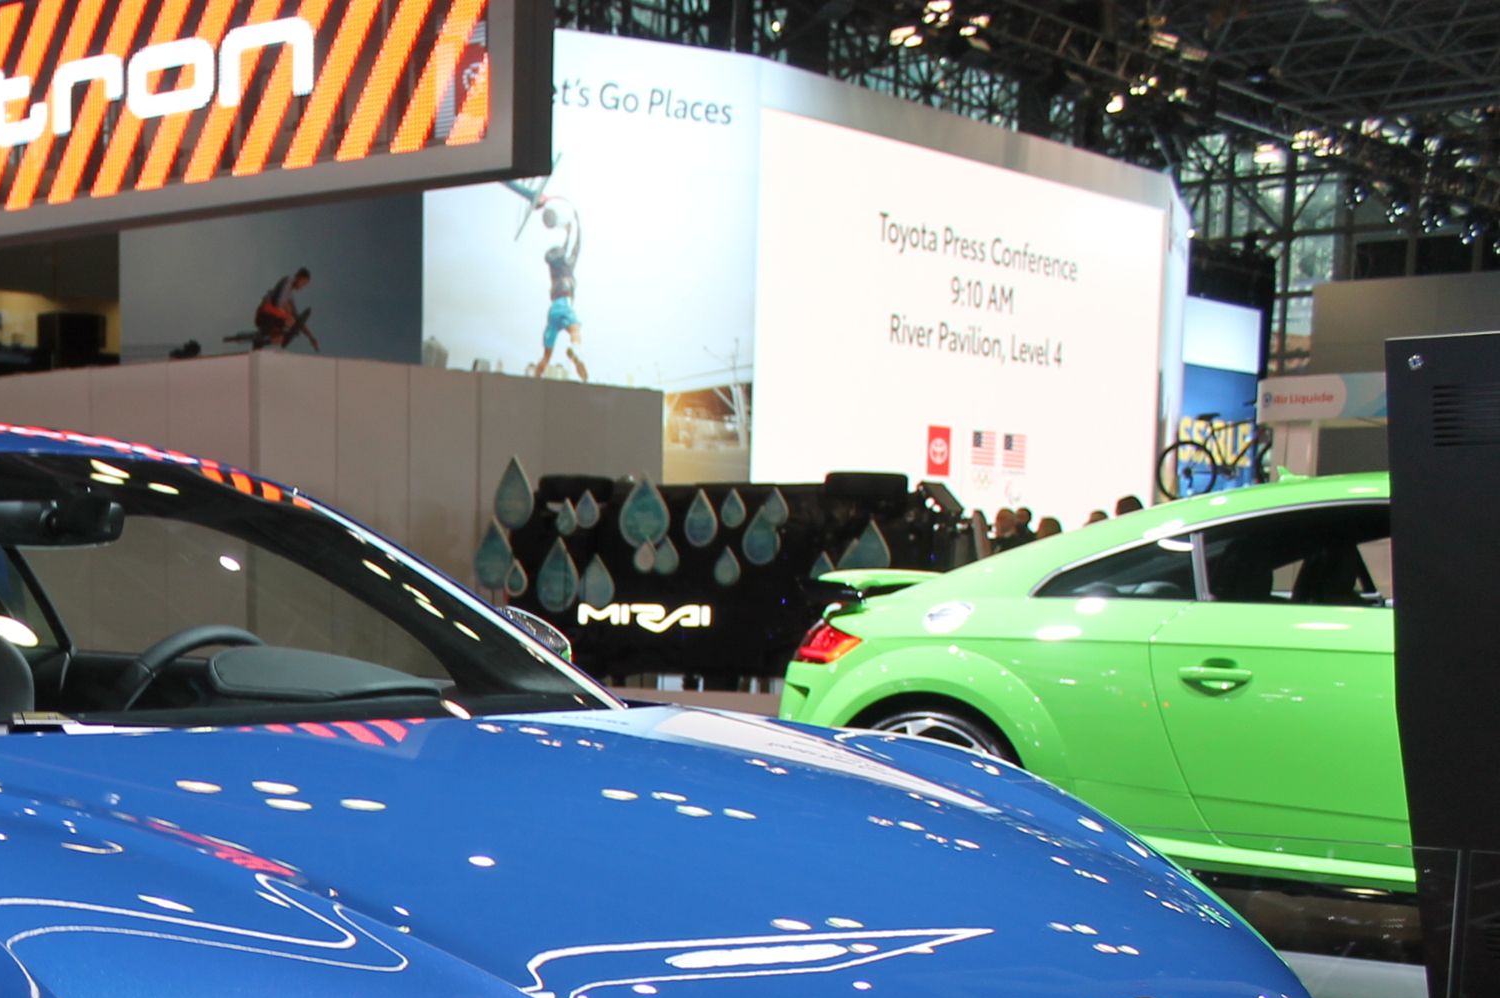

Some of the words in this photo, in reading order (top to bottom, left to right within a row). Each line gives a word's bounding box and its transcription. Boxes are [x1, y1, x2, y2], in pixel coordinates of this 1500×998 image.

[553, 79, 589, 108] t's
[599, 82, 639, 113] Go
[648, 88, 732, 125] Places
[879, 211, 938, 254] Toyota
[943, 226, 986, 263] Press
[991, 237, 1078, 282] Conference
[951, 275, 983, 309] 9:10
[987, 284, 1014, 315] AM
[889, 313, 933, 349] River
[938, 321, 1006, 365] Pavilion,
[1011, 333, 1050, 367] Level
[1054, 341, 1063, 368] 4
[577, 603, 711, 633] MIRAI
